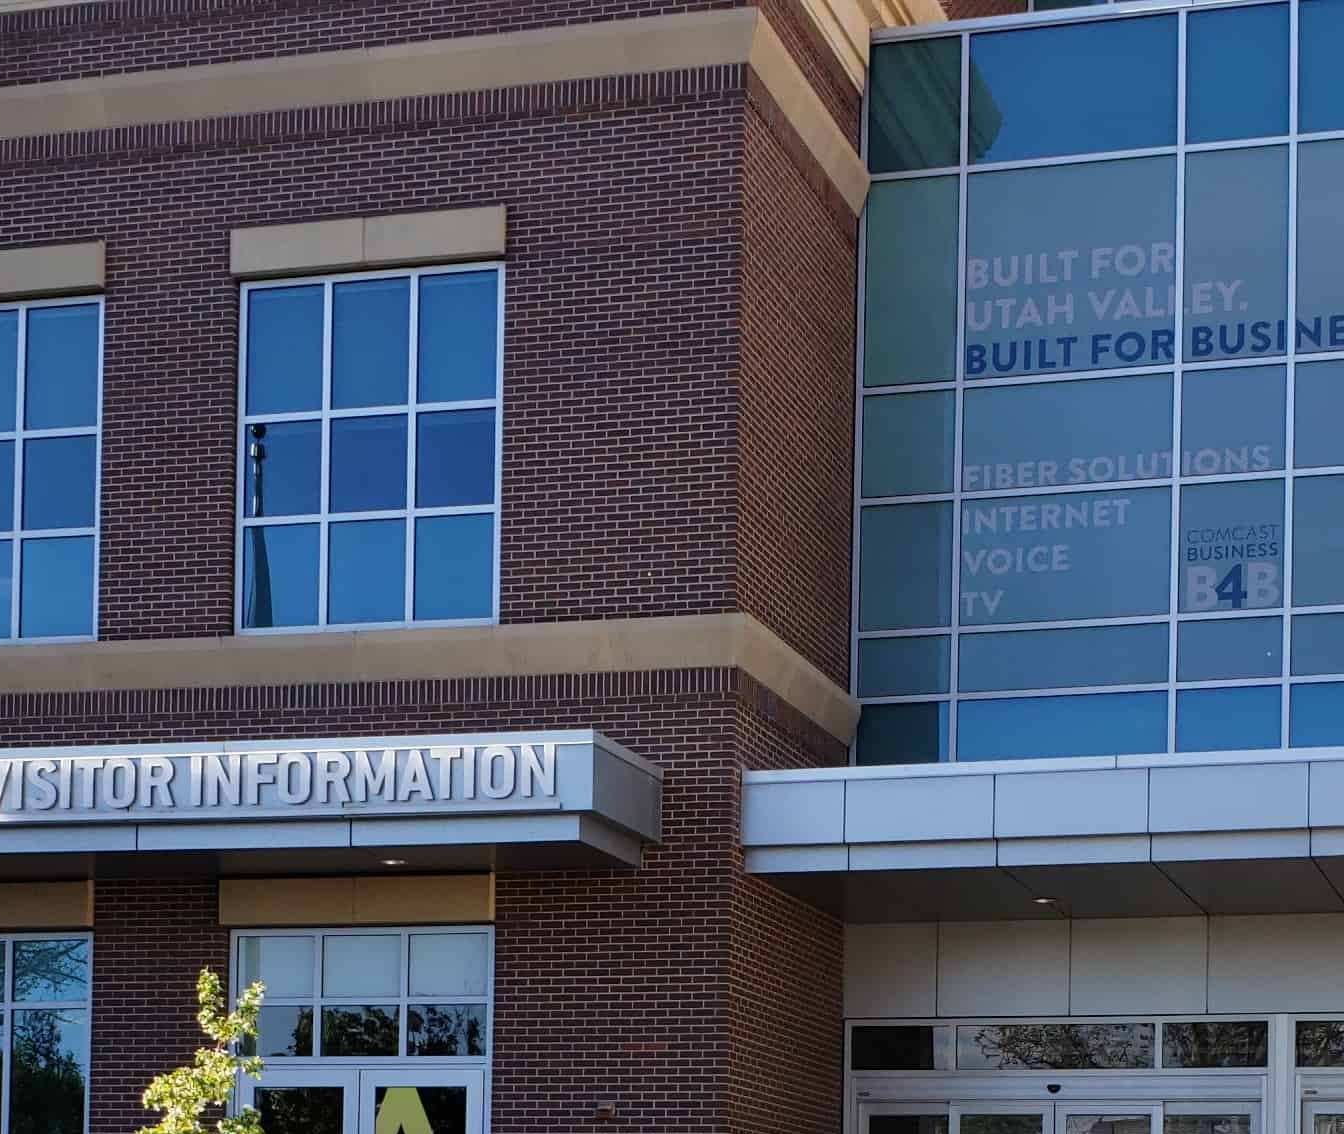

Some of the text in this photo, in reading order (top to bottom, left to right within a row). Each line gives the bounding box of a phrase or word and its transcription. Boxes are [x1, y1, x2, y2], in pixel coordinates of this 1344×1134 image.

[967, 242, 1175, 289] BUILT FOR
[968, 279, 1248, 332] UTAH VALLEY.
[966, 335, 1078, 375] BUILT
[1091, 328, 1175, 365] FOR
[963, 446, 1272, 491] FIBER SOLUTIONS
[961, 499, 1131, 536] INTERNET
[1186, 524, 1280, 545] COMCAST
[963, 544, 1071, 577] VOICE
[1187, 542, 1279, 562] BUSINESS
[960, 590, 1004, 617] TV
[1187, 562, 1281, 611] B4B
[190, 743, 556, 808] INFORMATION
